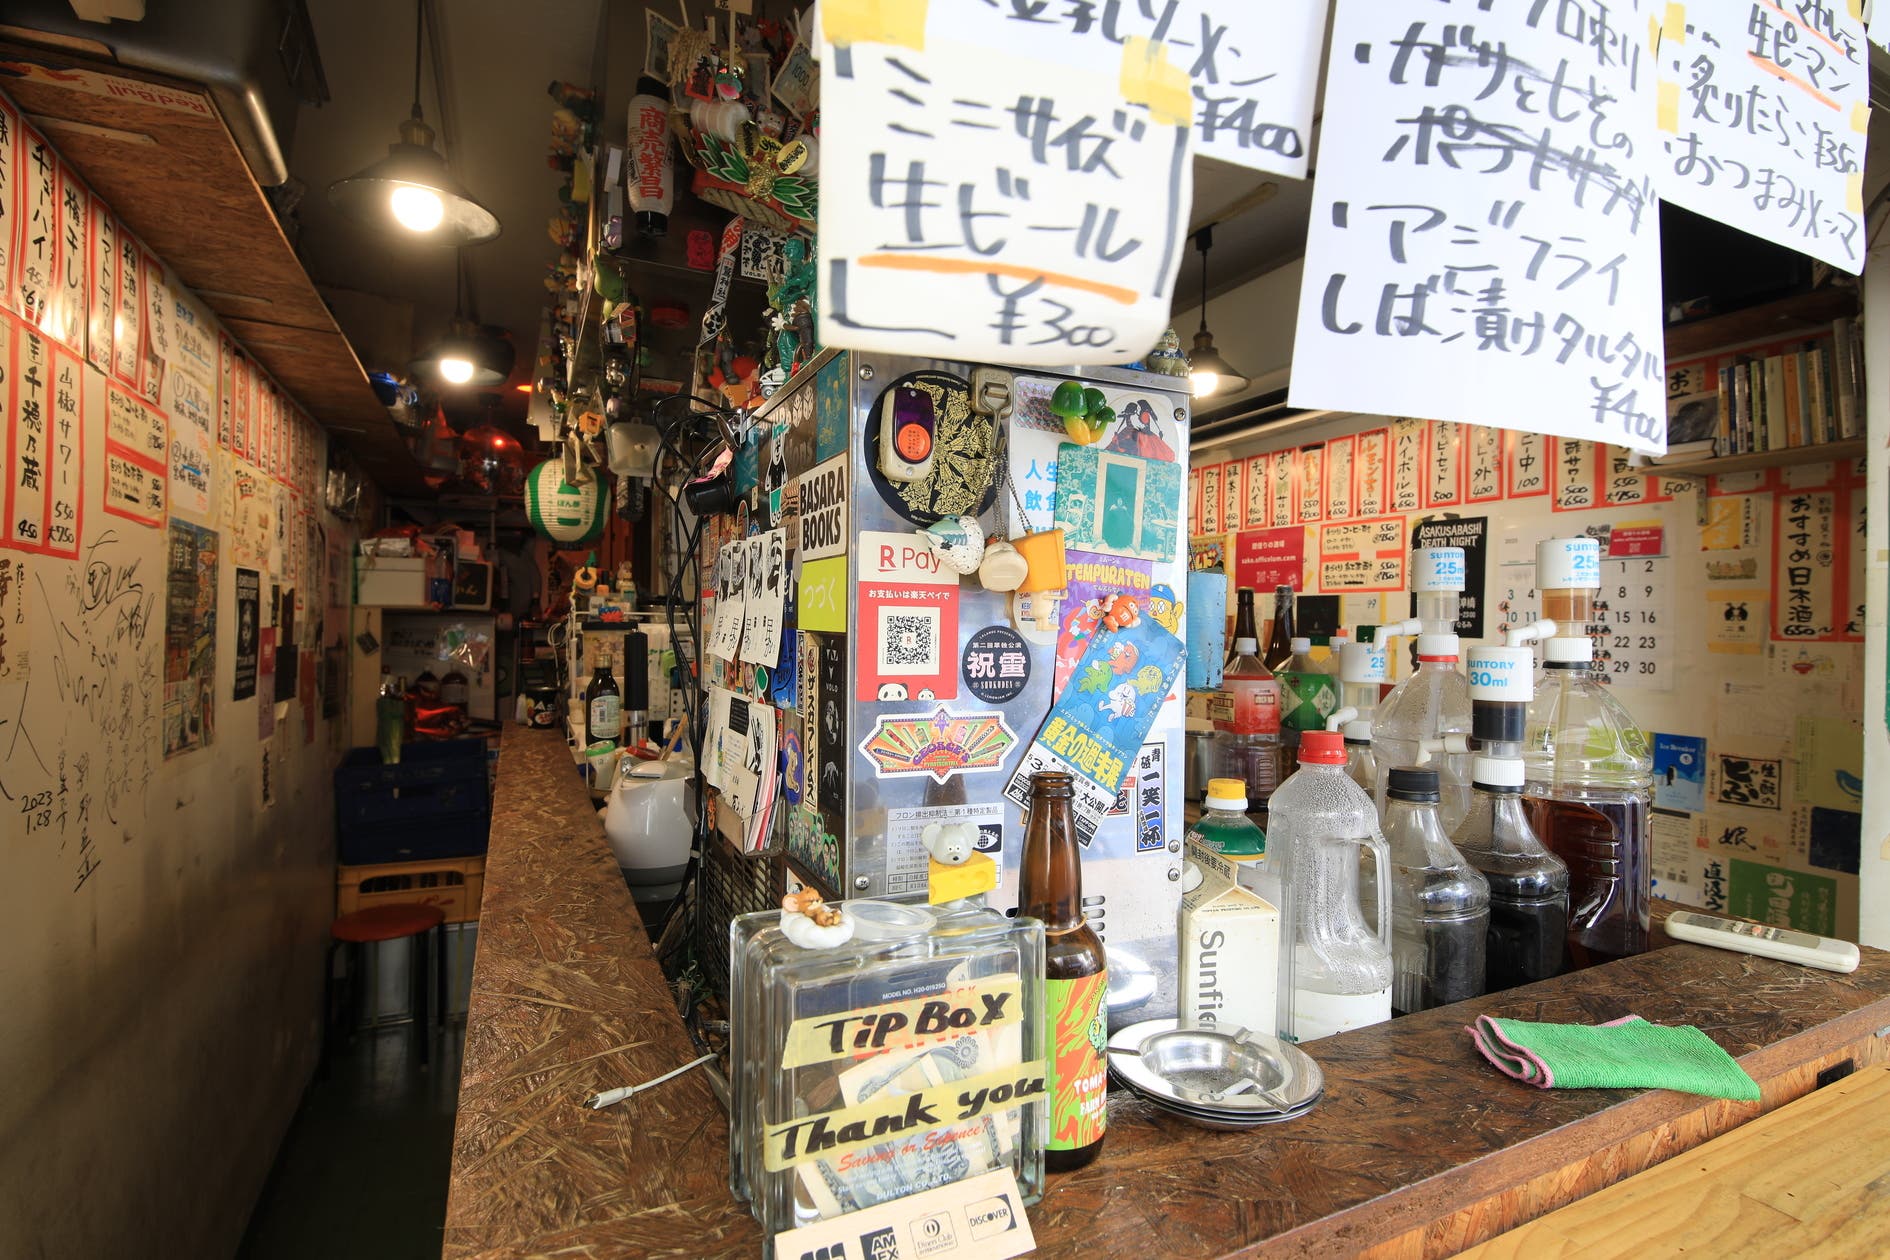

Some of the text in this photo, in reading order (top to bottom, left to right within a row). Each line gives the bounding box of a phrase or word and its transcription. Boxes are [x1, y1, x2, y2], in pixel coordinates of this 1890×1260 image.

[1749, 4, 1850, 91] 生ピーマン
[884, 57, 1146, 179] ミニサイズ
[870, 152, 1141, 262] 生ビール
[1366, 200, 1627, 305] アジフライ
[1320, 273, 1663, 381] しば漬けタルタル
[800, 466, 845, 517] BASARA
[1517, 477, 1539, 490] 100
[1433, 491, 1453, 502] 500
[18, 520, 38, 539] 450
[803, 506, 841, 552] BOOKS
[1419, 522, 1482, 538] ASAKUSABASHI
[1421, 535, 1478, 548] DEATH NIGHT
[903, 547, 941, 573] Pay
[1645, 561, 1654, 572] 2
[1788, 494, 1812, 623] おすすめ日本酒
[1066, 563, 1150, 589] TEMPURATEN
[804, 576, 836, 612] つづく
[868, 589, 950, 600] お支払いは楽天ペイで
[1508, 589, 1514, 600] 3
[1527, 589, 1535, 599] 4
[1618, 586, 1626, 598] 8
[1645, 586, 1653, 597] 9
[1506, 612, 1517, 622] 10
[1525, 612, 1537, 622] 11
[1615, 612, 1630, 623] 15
[1641, 612, 1656, 623] 16
[1614, 637, 1630, 648] 22
[1639, 637, 1656, 648] 23
[1614, 661, 1629, 672] 29
[1639, 662, 1656, 673] 30
[1470, 672, 1508, 686] 30ml
[21, 791, 53, 813] 2023
[1142, 771, 1161, 848] 一笑一杯
[882, 988, 912, 1000] MODEL NO.
[771, 1077, 1046, 1161] Thank you
[902, 1143, 916, 1154] or
[876, 1183, 913, 1201] DULTON
[970, 1208, 1008, 1227] DISCOVER
